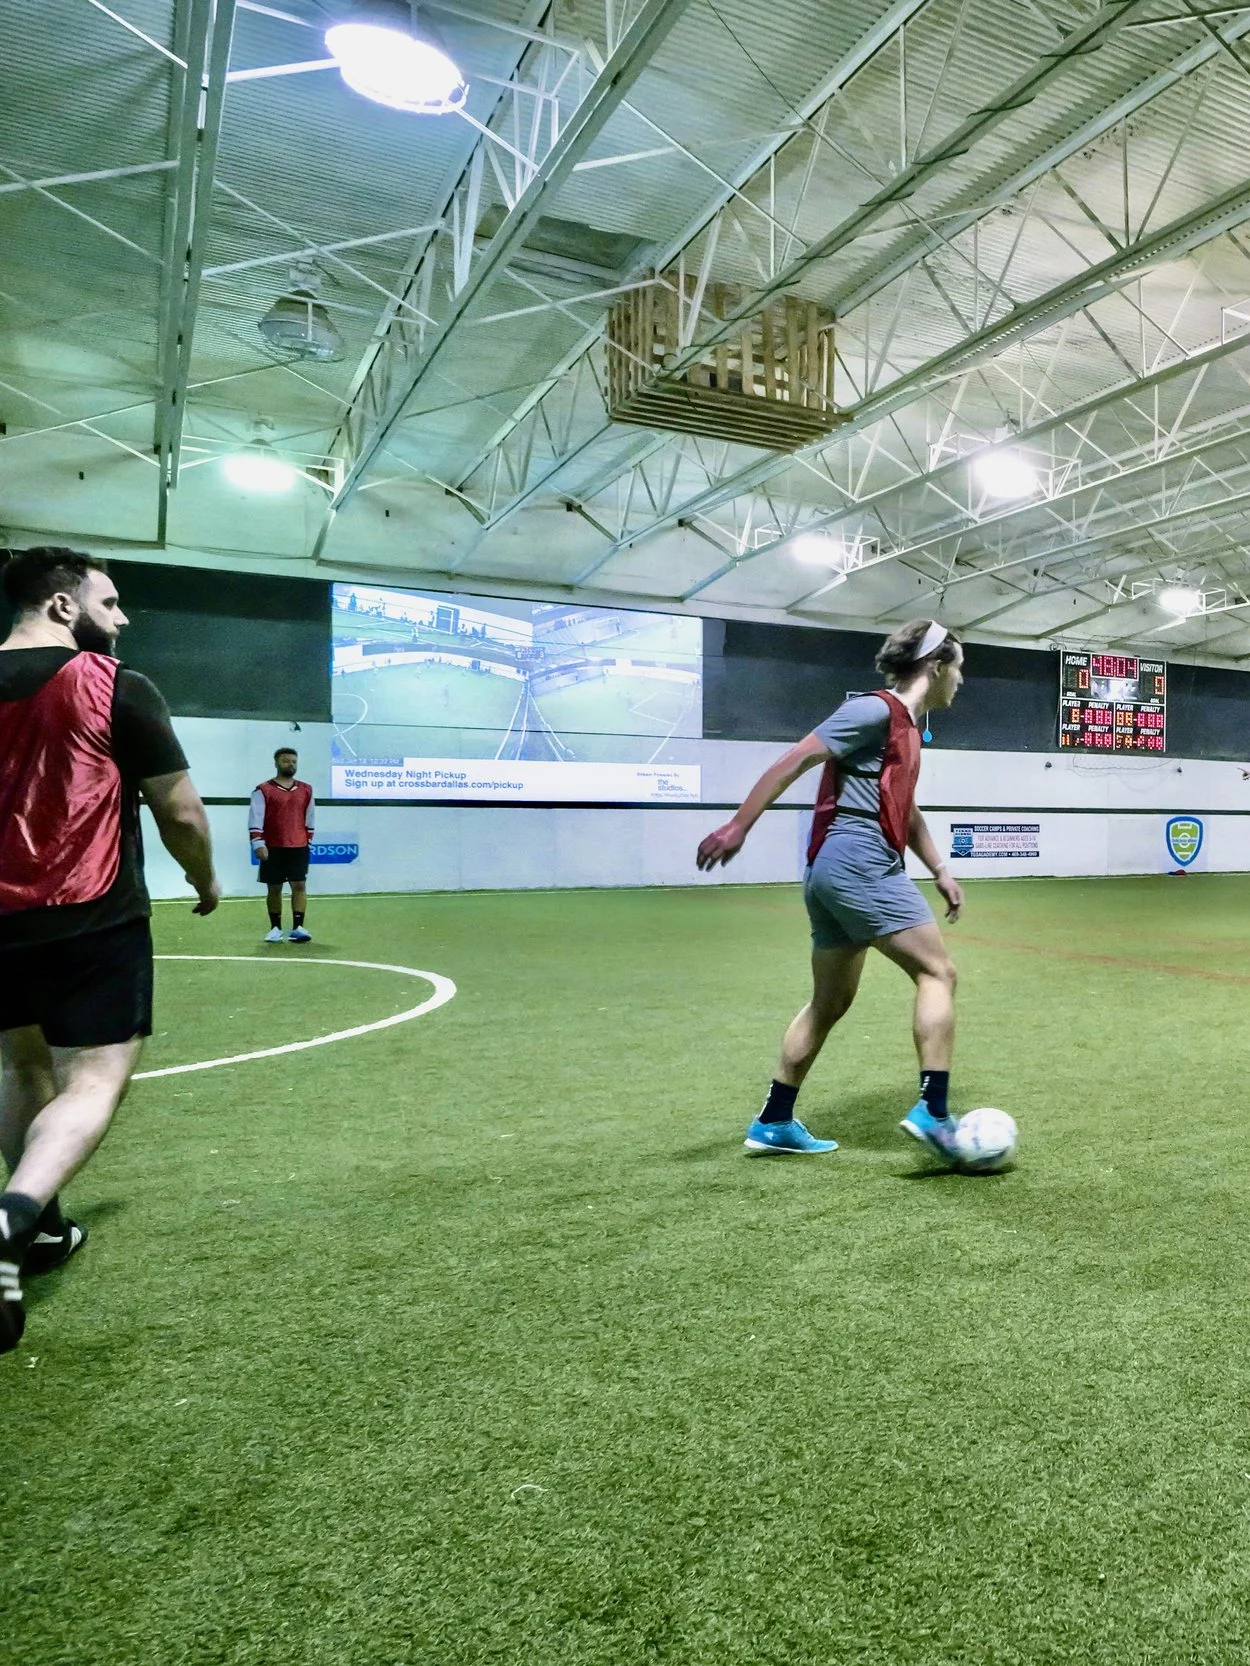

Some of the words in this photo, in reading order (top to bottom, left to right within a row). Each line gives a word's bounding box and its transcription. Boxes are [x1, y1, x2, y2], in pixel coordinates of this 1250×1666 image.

[1065, 655, 1088, 666] HOME
[1092, 655, 1137, 679] 48:04
[1140, 662, 1163, 673] VISITOR
[1078, 669, 1089, 689] 0
[1140, 705, 1160, 713] PENALTY
[345, 769, 403, 780] Wednesday
[406, 770, 432, 780] Night
[434, 771, 467, 780] Pickup
[345, 779, 368, 788] Sign
[398, 780, 524, 790] crossbardallas.com/pickup
